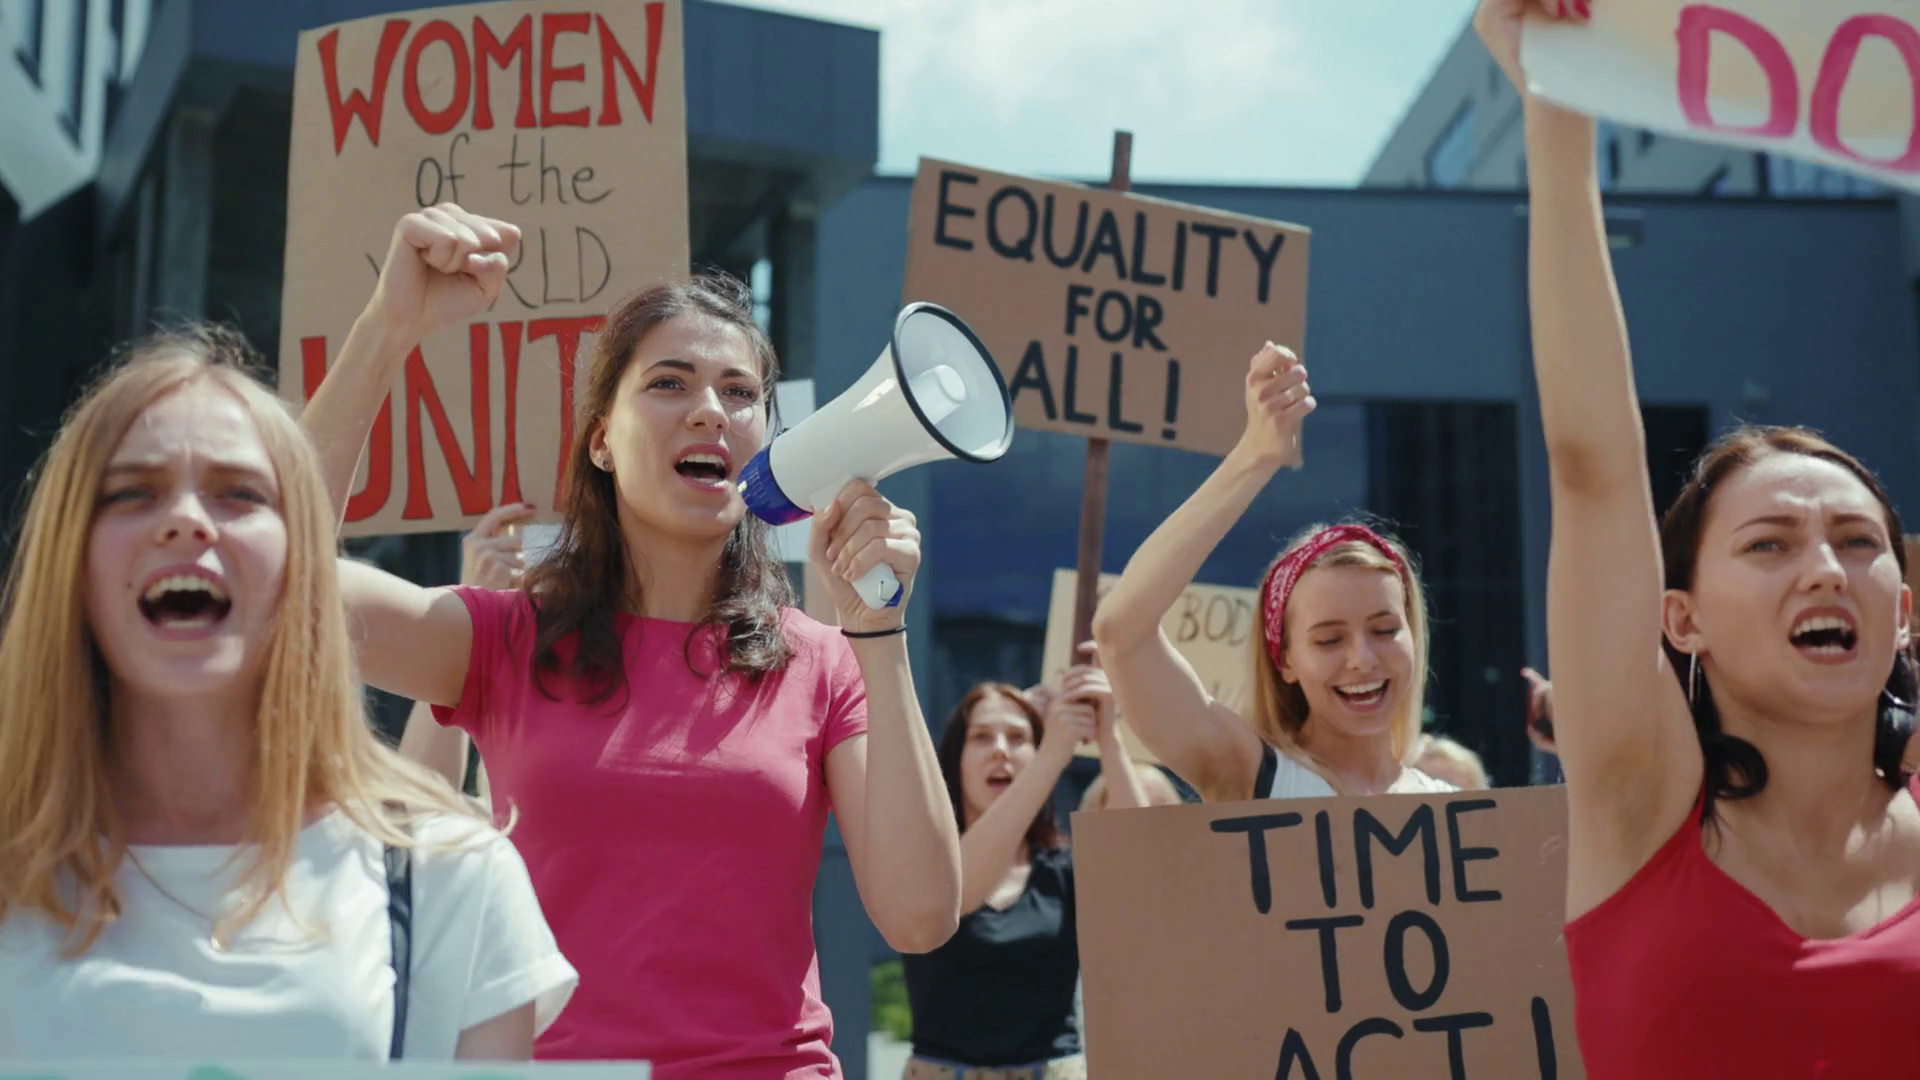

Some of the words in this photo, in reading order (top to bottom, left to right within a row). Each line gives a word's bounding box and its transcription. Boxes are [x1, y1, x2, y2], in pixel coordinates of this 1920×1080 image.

[317, 2, 665, 157] WOMEN
[416, 133, 470, 208] of
[498, 134, 614, 206] the
[934, 170, 1286, 305] EQUALITY
[1065, 283, 1169, 352] FOR
[1009, 340, 1180, 440] ALL!
[1210, 799, 1502, 914] TIME
[1285, 910, 1450, 1013] TO
